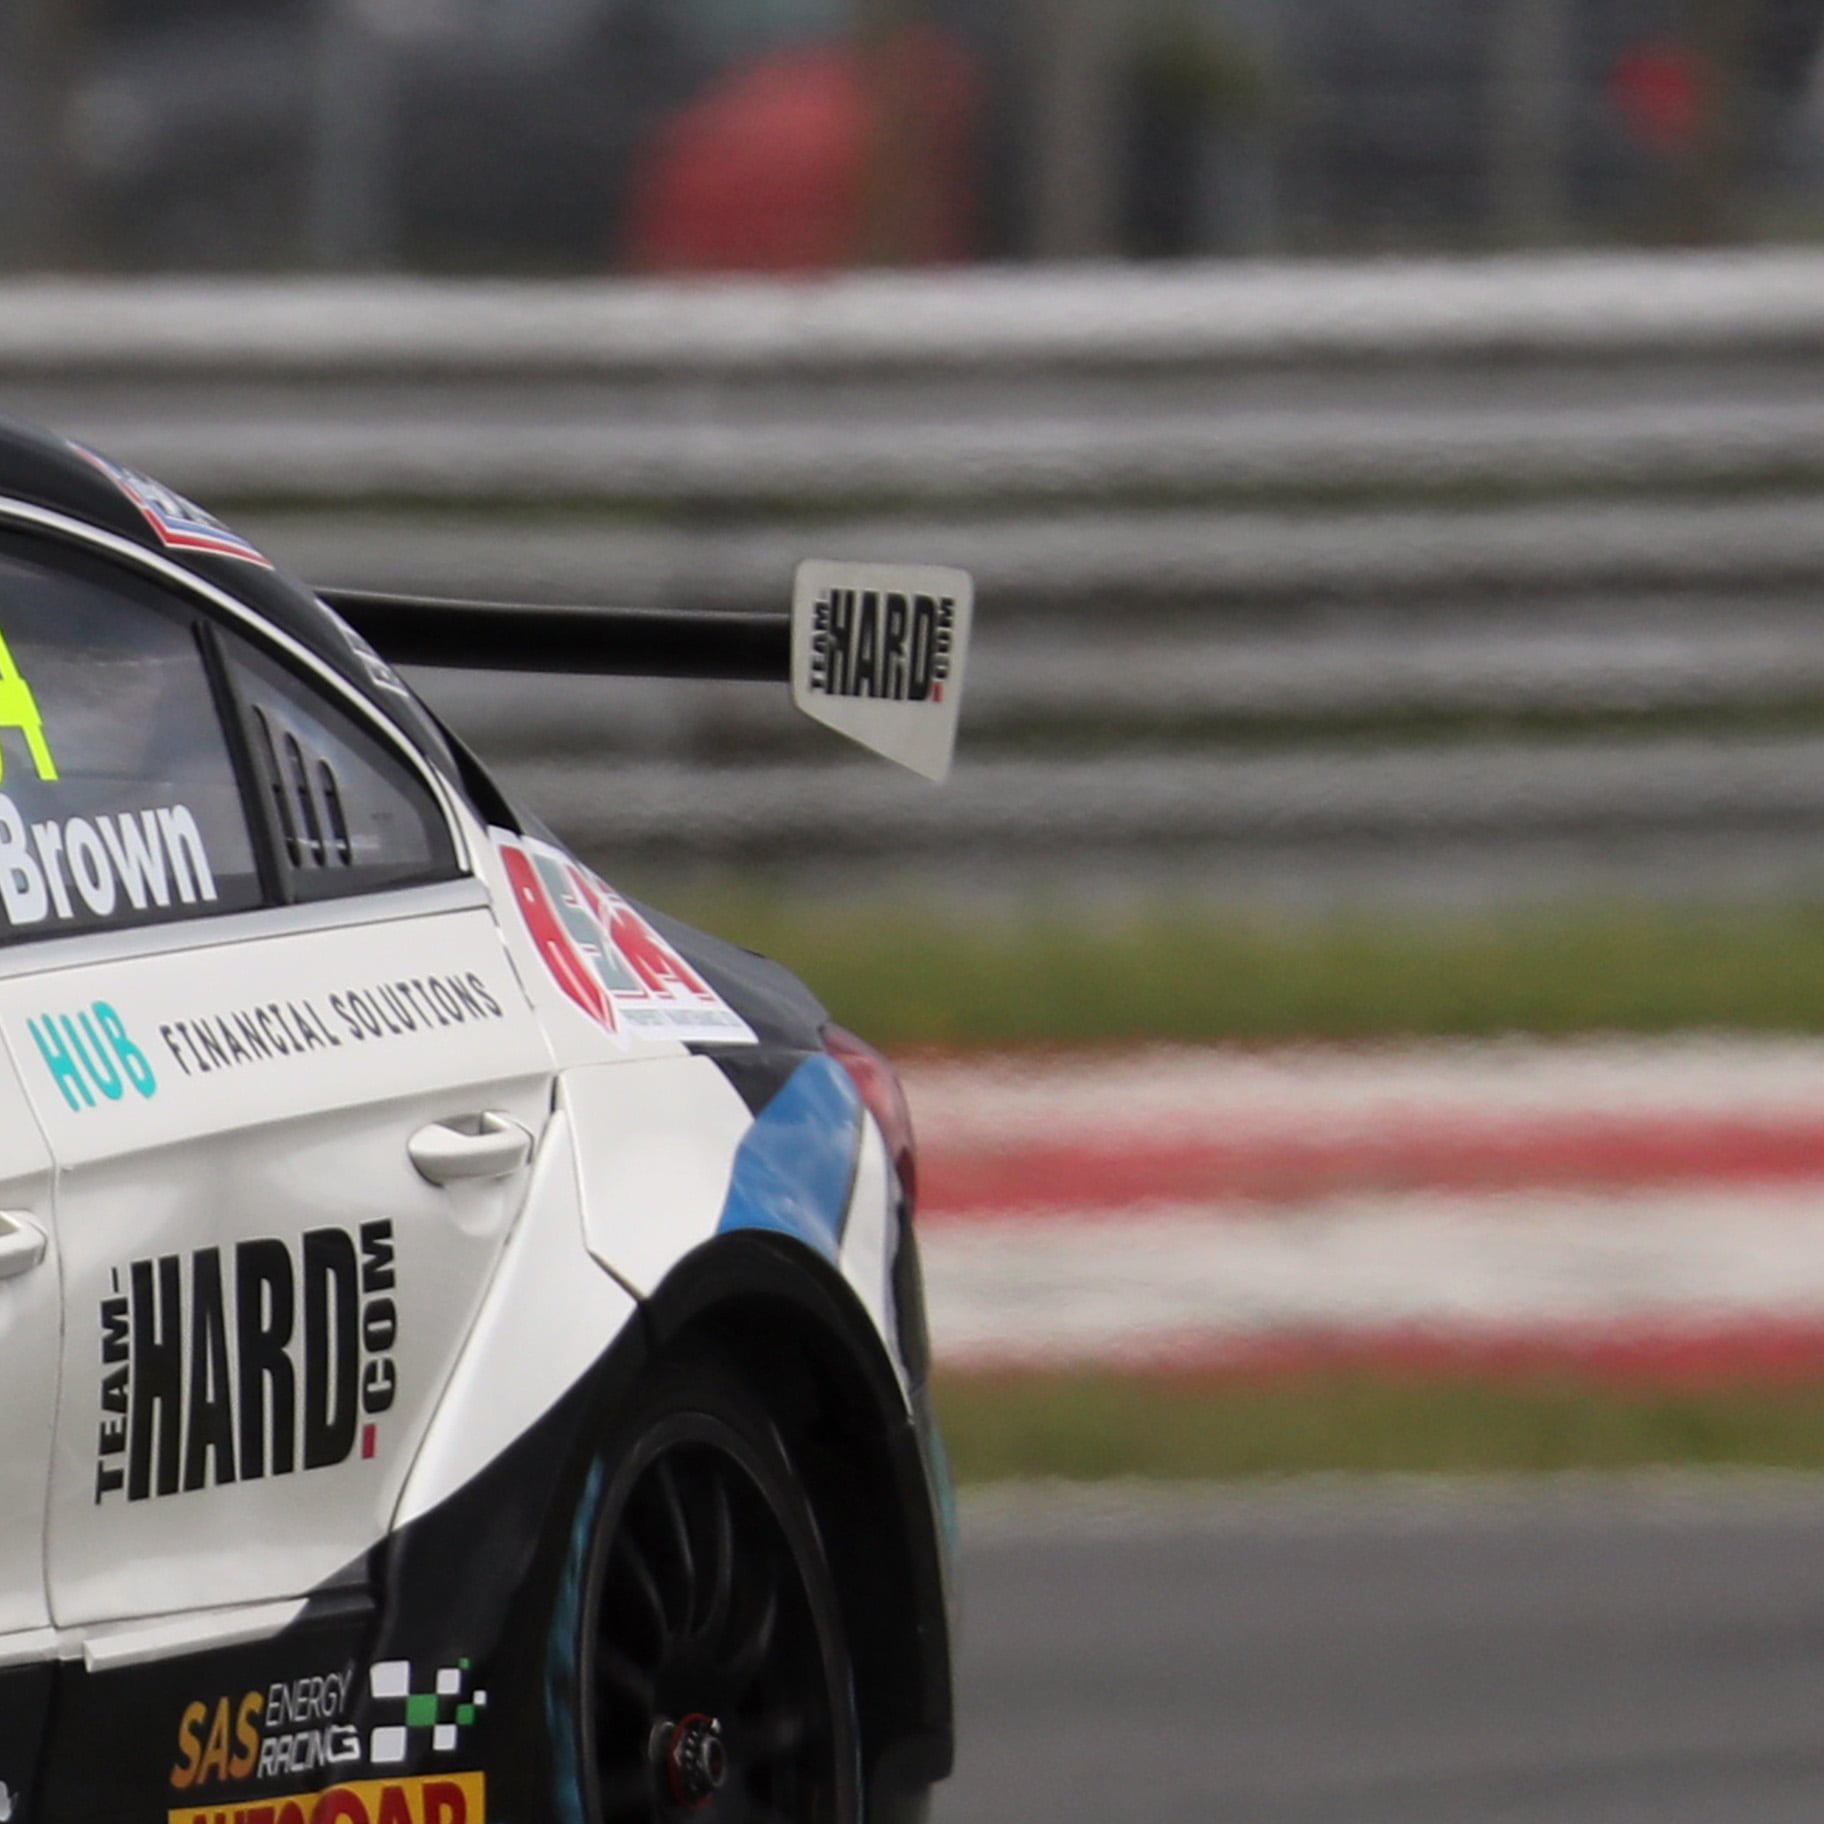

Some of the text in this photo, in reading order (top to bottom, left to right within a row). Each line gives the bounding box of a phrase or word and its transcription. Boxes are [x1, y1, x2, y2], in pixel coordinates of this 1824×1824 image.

[825, 589, 935, 700] HARD
[27, 971, 504, 1112] HUB FINANCIAL SOLUTIONS
[127, 1227, 358, 1502] HARD
[170, 1691, 264, 1788] SAS
[265, 1670, 352, 1727] ENERGY
[256, 1724, 361, 1779] RACING
